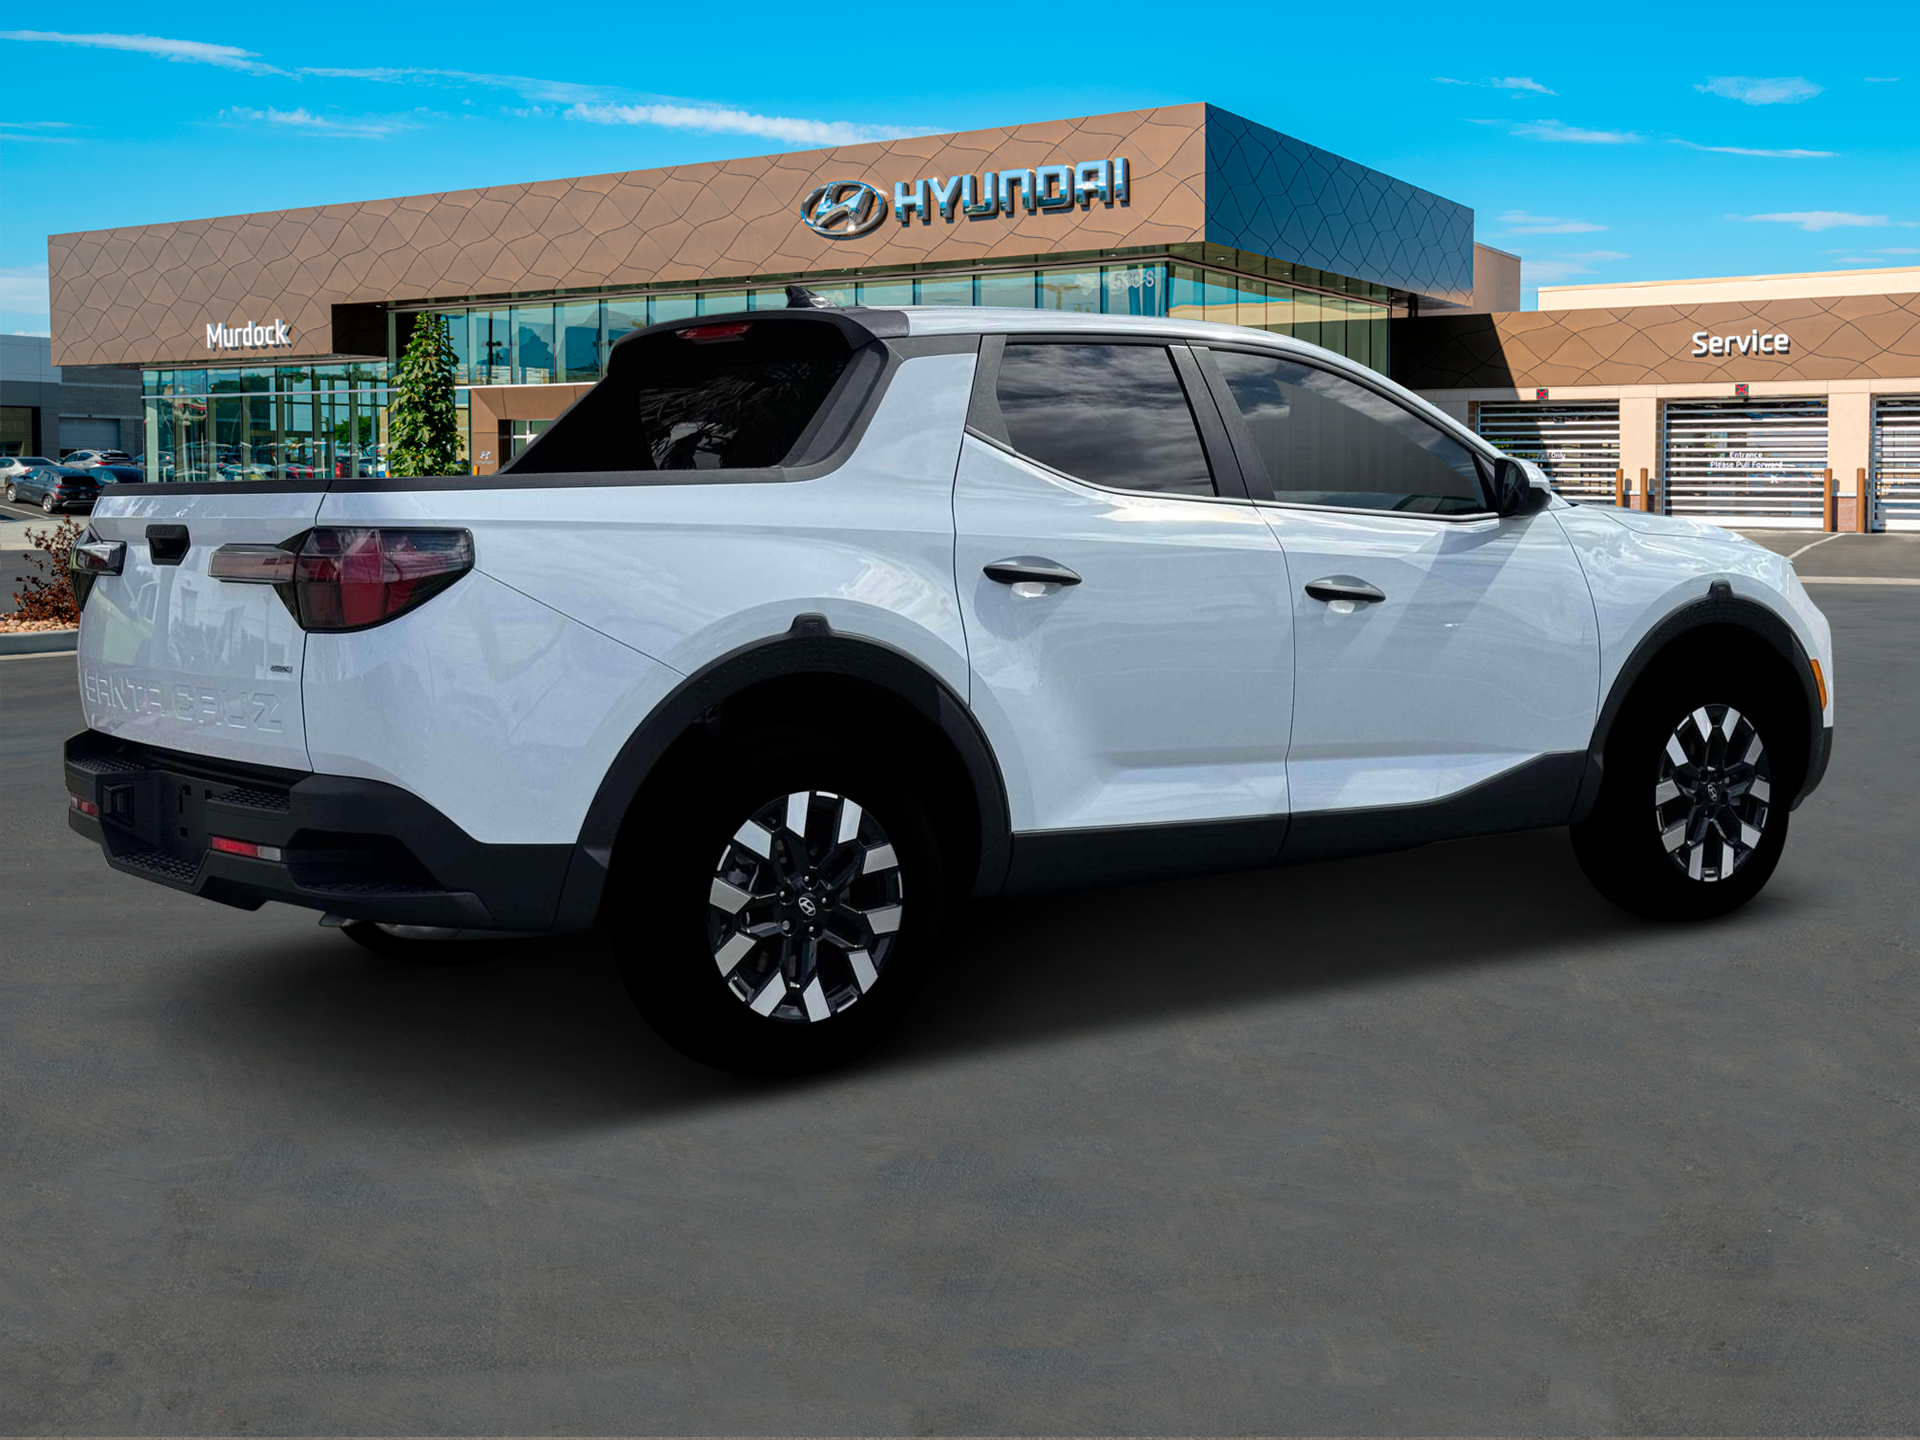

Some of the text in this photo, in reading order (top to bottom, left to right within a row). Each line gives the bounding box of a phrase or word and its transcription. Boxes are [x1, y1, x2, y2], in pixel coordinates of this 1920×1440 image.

[895, 157, 1129, 222] HYUNDAI
[1114, 270, 1155, 289] 530 S
[205, 318, 291, 349] Murdock
[1691, 329, 1789, 354] Service
